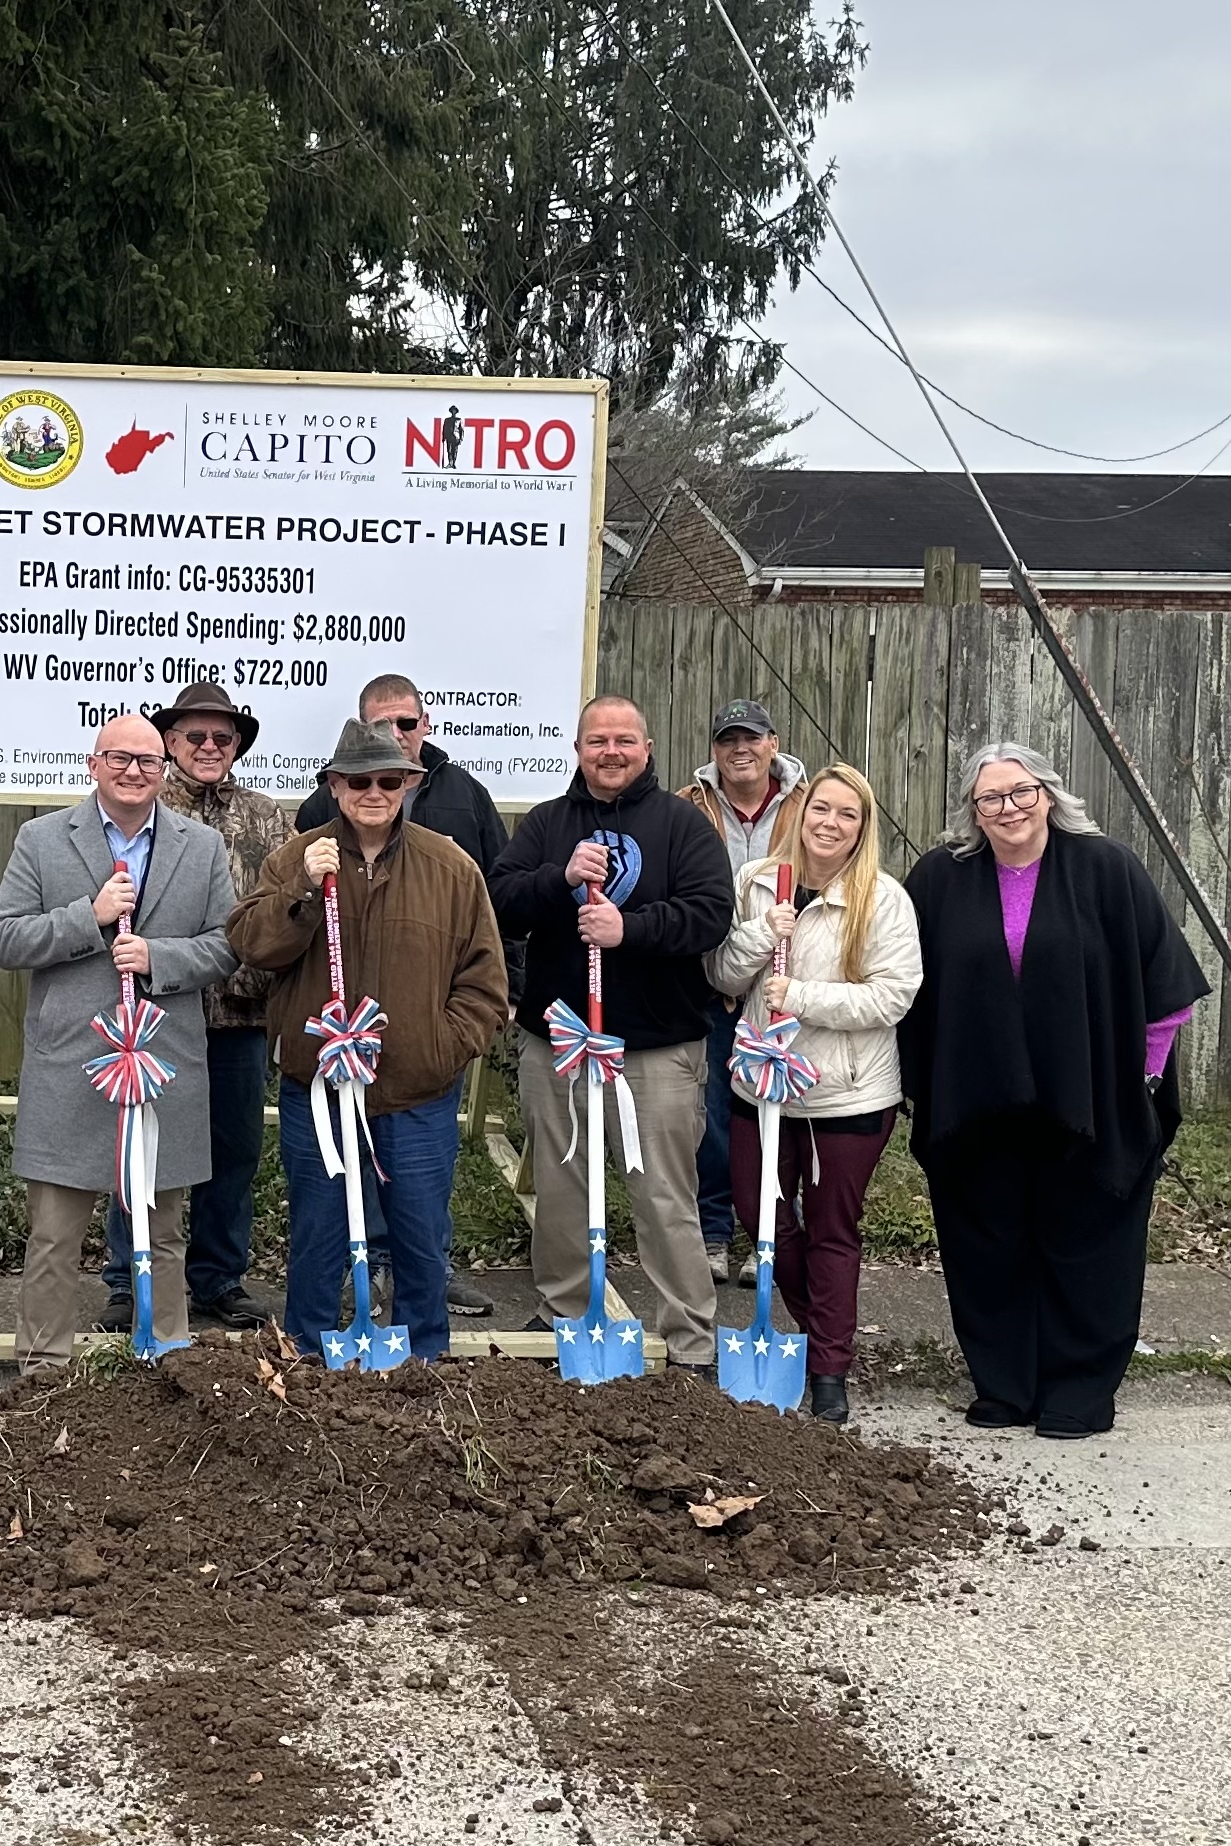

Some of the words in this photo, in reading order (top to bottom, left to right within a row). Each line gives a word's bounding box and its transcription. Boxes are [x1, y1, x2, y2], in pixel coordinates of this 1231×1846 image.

[1, 400, 14, 416] OF
[15, 394, 50, 405] WEST
[50, 399, 79, 444] VIRGINIA
[202, 412, 286, 426] SHELLEY
[304, 415, 377, 428] MOORE
[201, 432, 375, 464] CAPITO
[200, 467, 230, 478] United
[233, 468, 259, 478] States
[263, 469, 295, 479] Senator
[294, 470, 311, 482] for
[315, 470, 336, 480] West
[341, 471, 375, 484] Virginia
[405, 477, 413, 487] A
[416, 478, 447, 491] Living
[450, 475, 499, 489] Memorial
[501, 481, 510, 489] to
[513, 480, 543, 490] World
[546, 480, 567, 490] War
[570, 481, 573, 491] I
[43, 511, 265, 540] STORMWATER
[446, 521, 548, 546] PHASE
[559, 523, 565, 546] I
[20, 561, 58, 588] EPA
[66, 562, 120, 589] Grant
[128, 564, 170, 591] info:
[179, 565, 314, 594] CG-95335301
[95, 609, 178, 637] Directed
[187, 611, 285, 645] Spending:
[293, 612, 405, 646] $2,880,000
[4, 654, 38, 680] WV
[160, 655, 227, 684] Office:
[234, 657, 327, 690] $722,000
[443, 722, 533, 740] Reclamation,
[539, 723, 563, 737] Inc.
[240, 753, 268, 768] with
[508, 758, 572, 776] (FY2022),
[11, 771, 63, 787] support
[238, 774, 272, 789] nator
